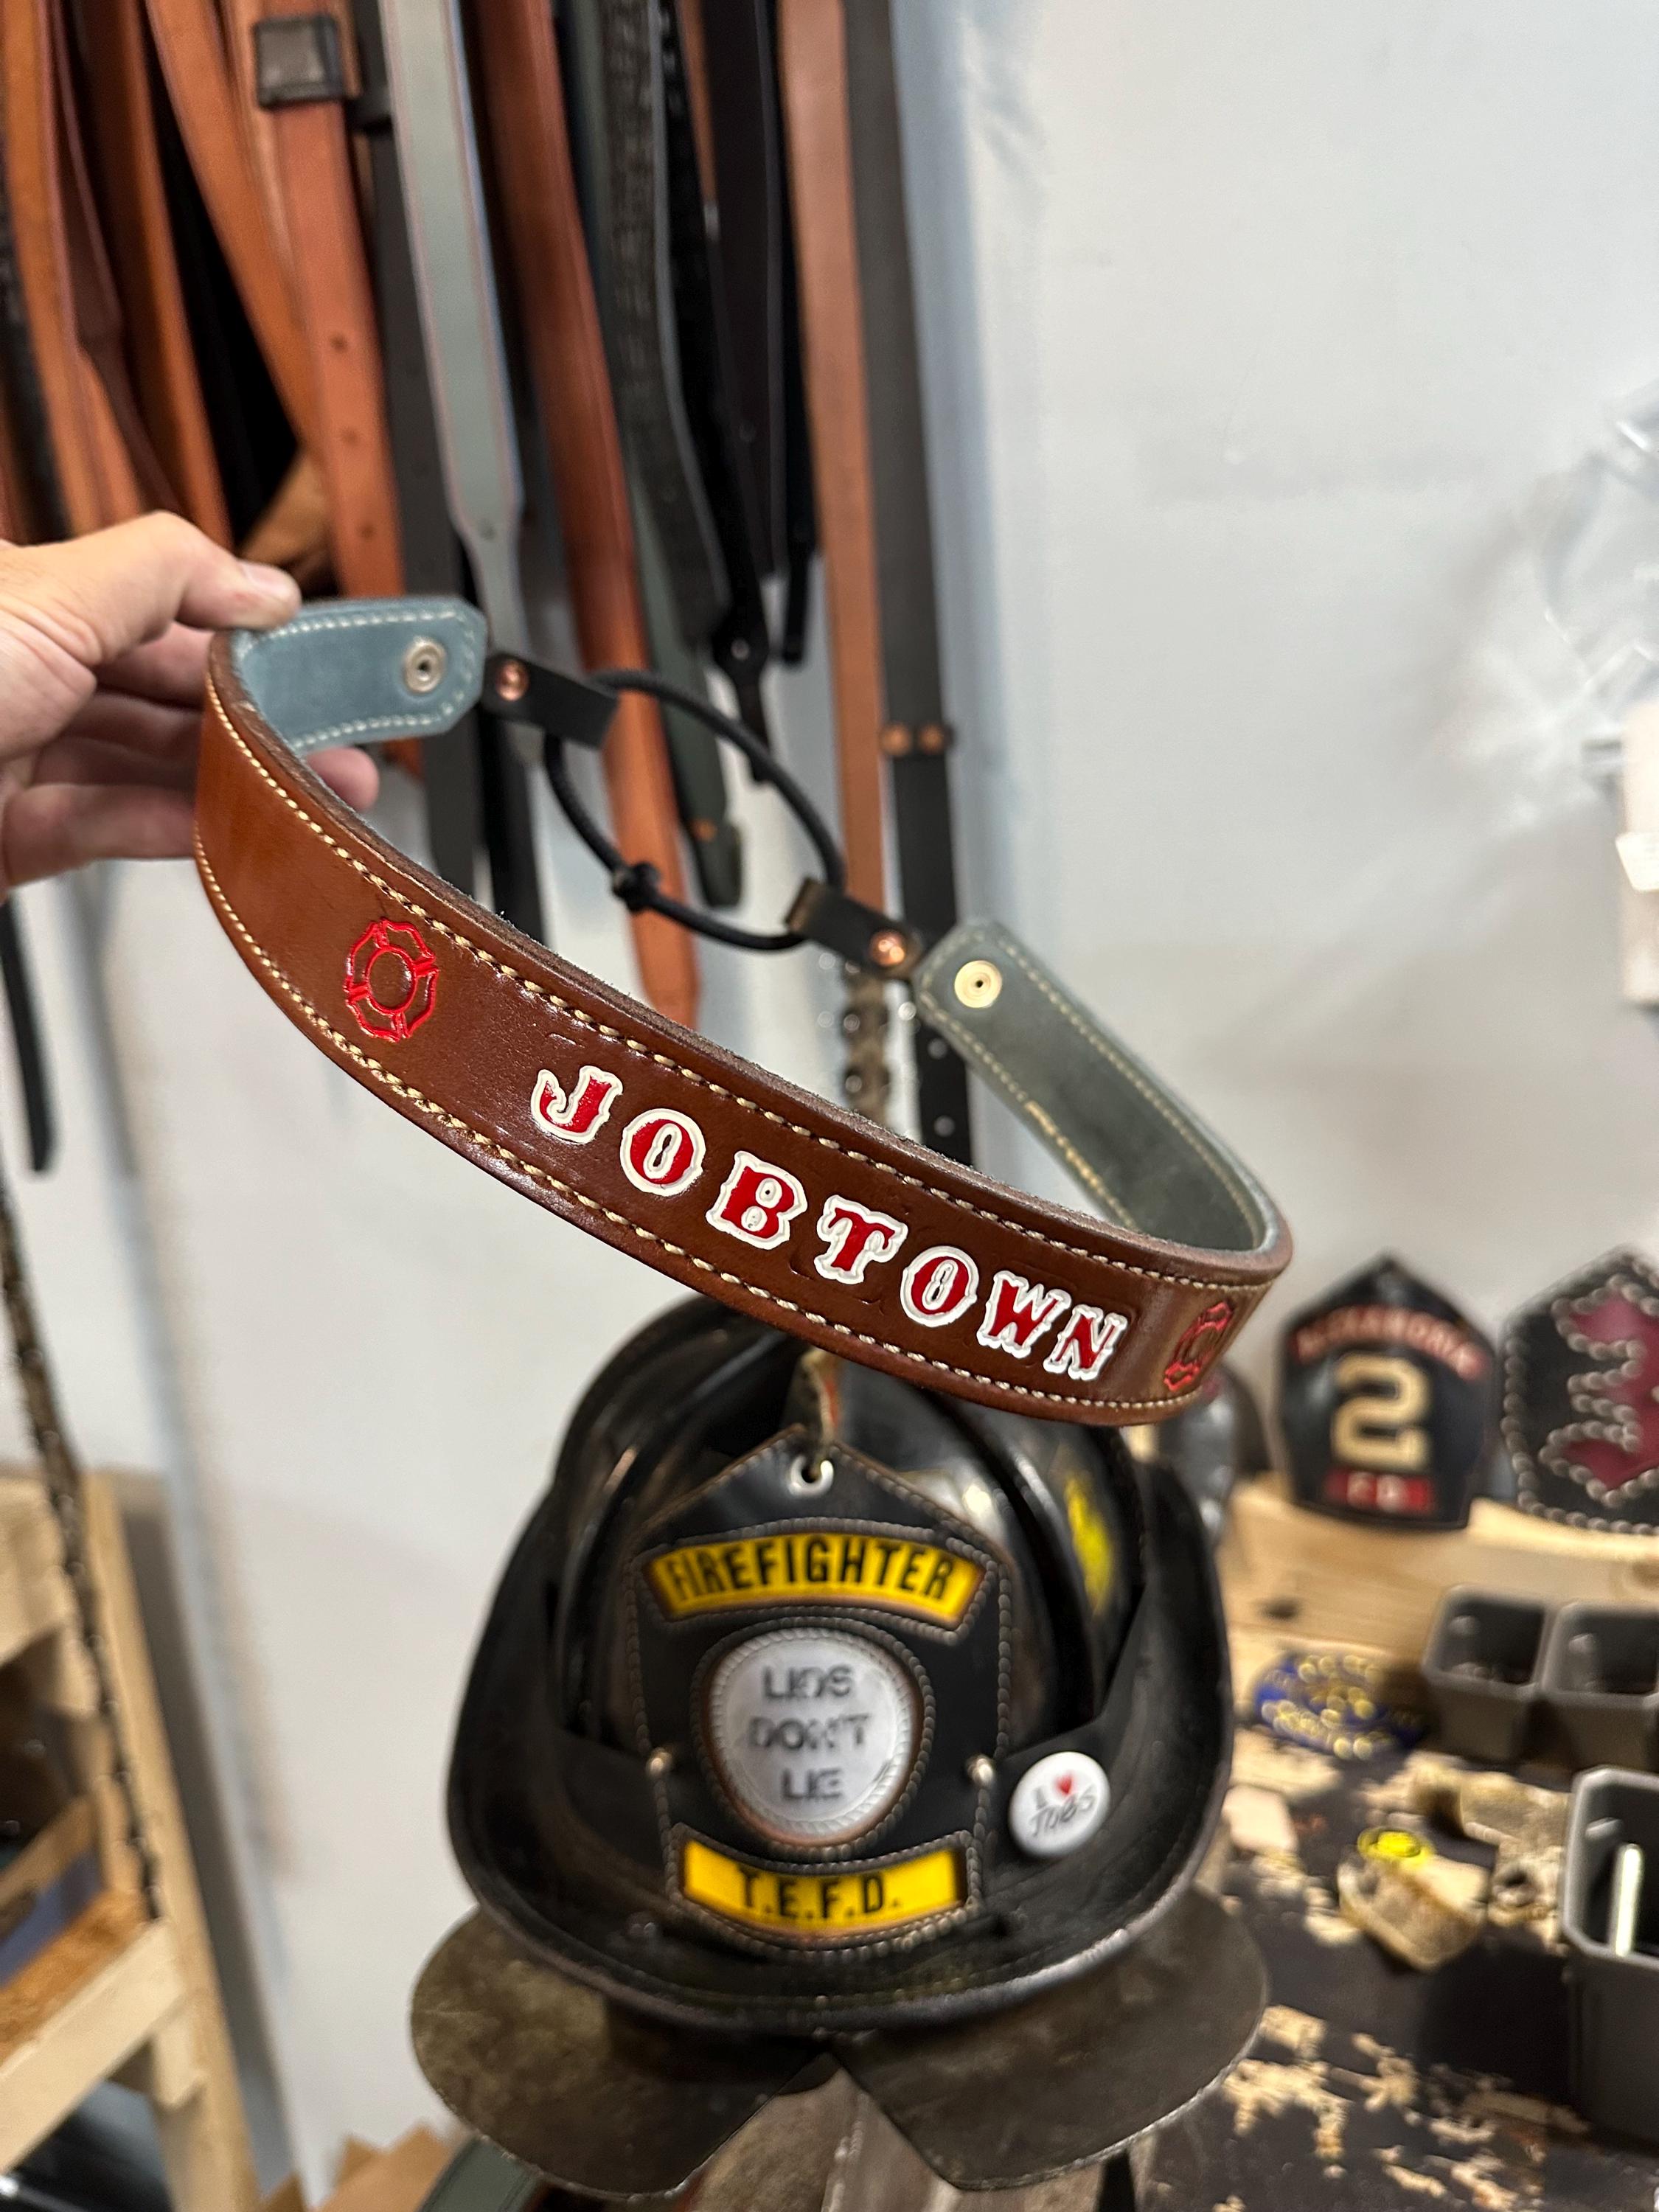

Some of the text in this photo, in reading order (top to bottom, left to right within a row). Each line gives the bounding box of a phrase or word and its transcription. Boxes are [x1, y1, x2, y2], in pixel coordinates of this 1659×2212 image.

[531, 1065, 1128, 1381] JOBTOWN
[1331, 1352, 1429, 1469] 2
[666, 1536, 955, 1601] FIREFIGHTER
[762, 1663, 852, 1699] LIDS
[748, 1712, 871, 1751] DON'T
[782, 1767, 841, 1800] LIE
[740, 1870, 901, 1920] T.E.F.D.
